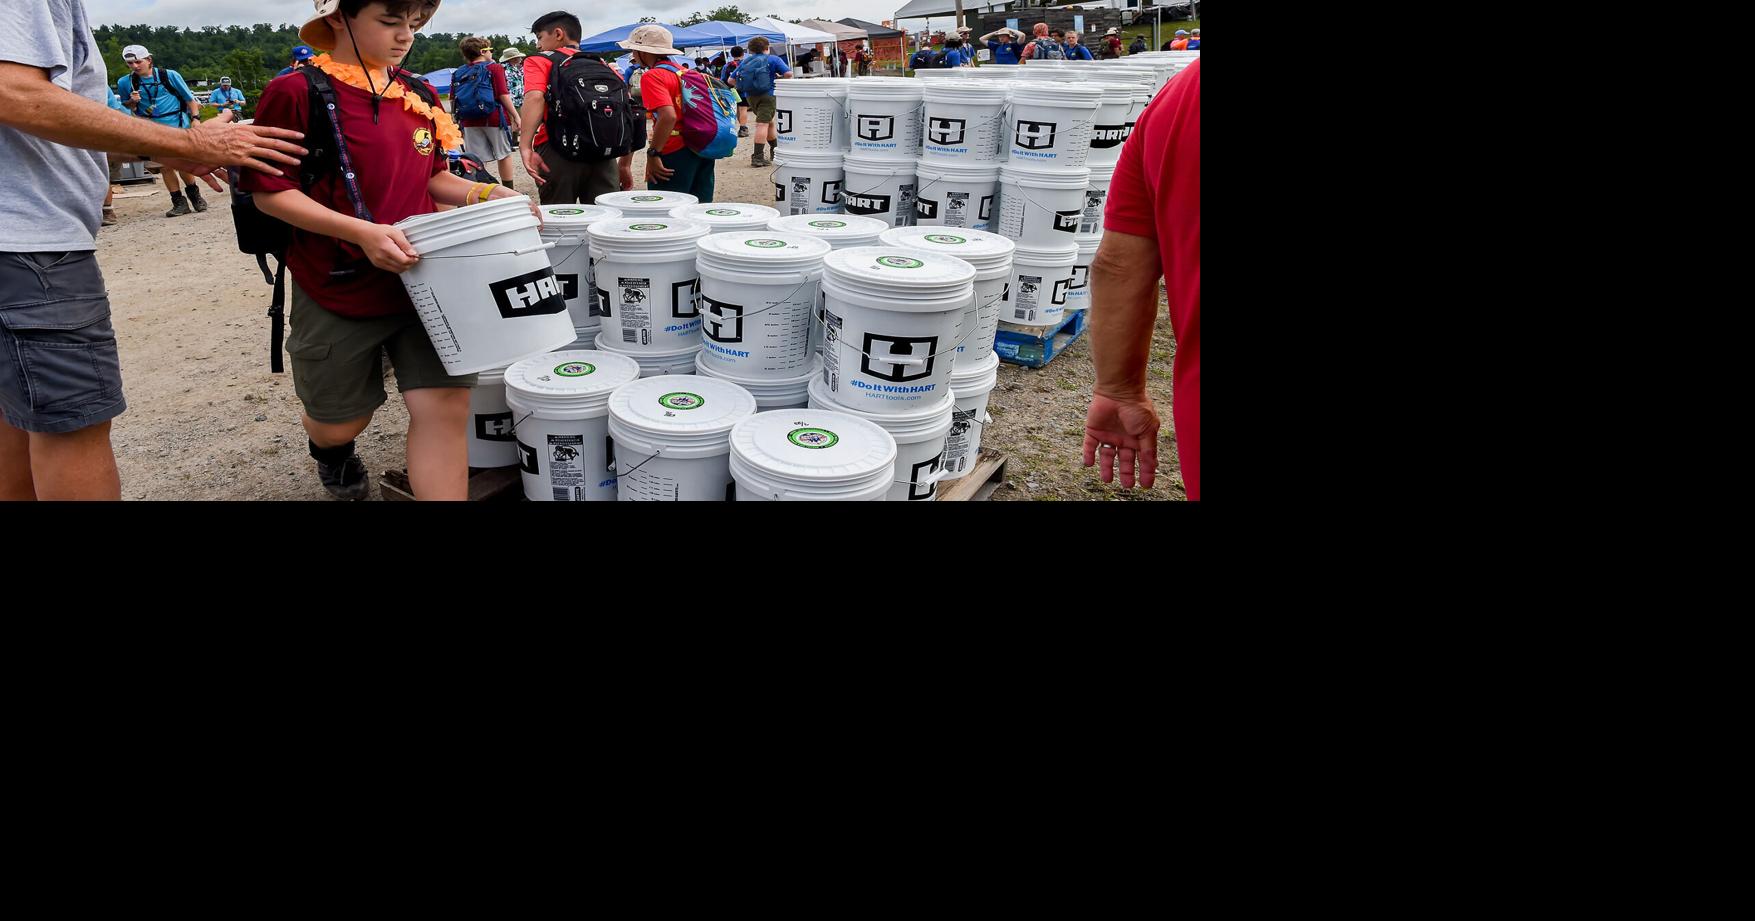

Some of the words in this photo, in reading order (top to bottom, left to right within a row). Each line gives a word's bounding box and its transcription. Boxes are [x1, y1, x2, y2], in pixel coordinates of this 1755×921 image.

[931, 119, 963, 144] H
[1018, 123, 1052, 147] H
[845, 195, 884, 210] ART
[867, 338, 932, 378] H
